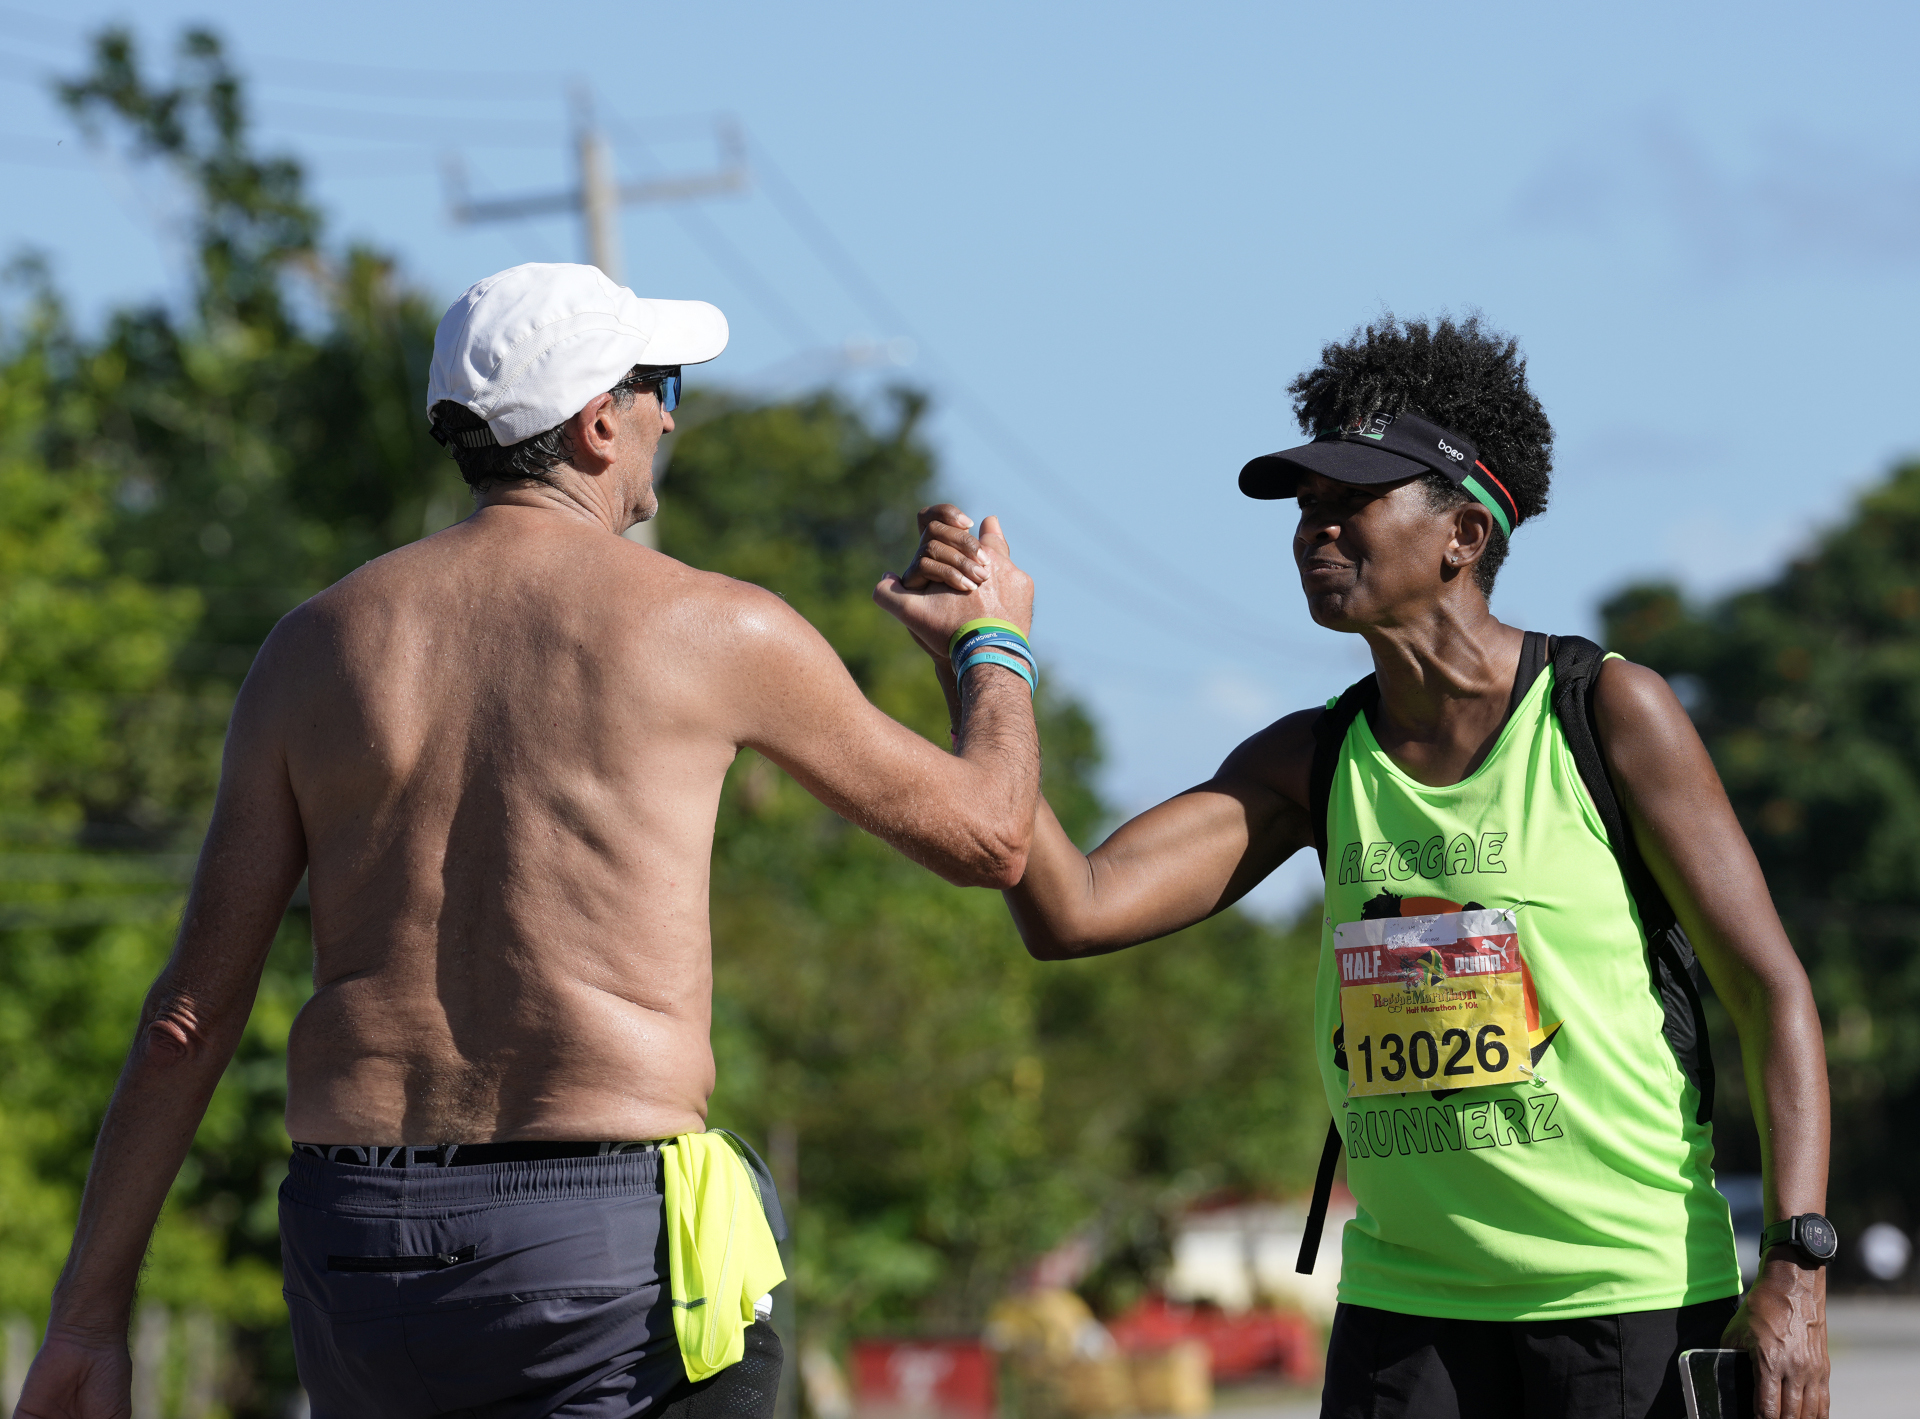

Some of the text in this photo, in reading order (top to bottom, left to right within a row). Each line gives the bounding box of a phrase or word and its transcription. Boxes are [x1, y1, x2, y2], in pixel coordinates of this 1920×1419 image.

[1437, 439, 1464, 461] boco
[985, 653, 1012, 664] Berlin
[1339, 832, 1508, 885] REGGAE
[1342, 950, 1382, 980] HALF
[1454, 954, 1501, 974] PUMA
[1406, 1006, 1419, 1014] Half
[1421, 1004, 1456, 1013] Marathon
[1464, 1001, 1478, 1009] 10k
[1357, 1024, 1509, 1082] 13026
[1347, 1092, 1563, 1158] RUNNERZ
